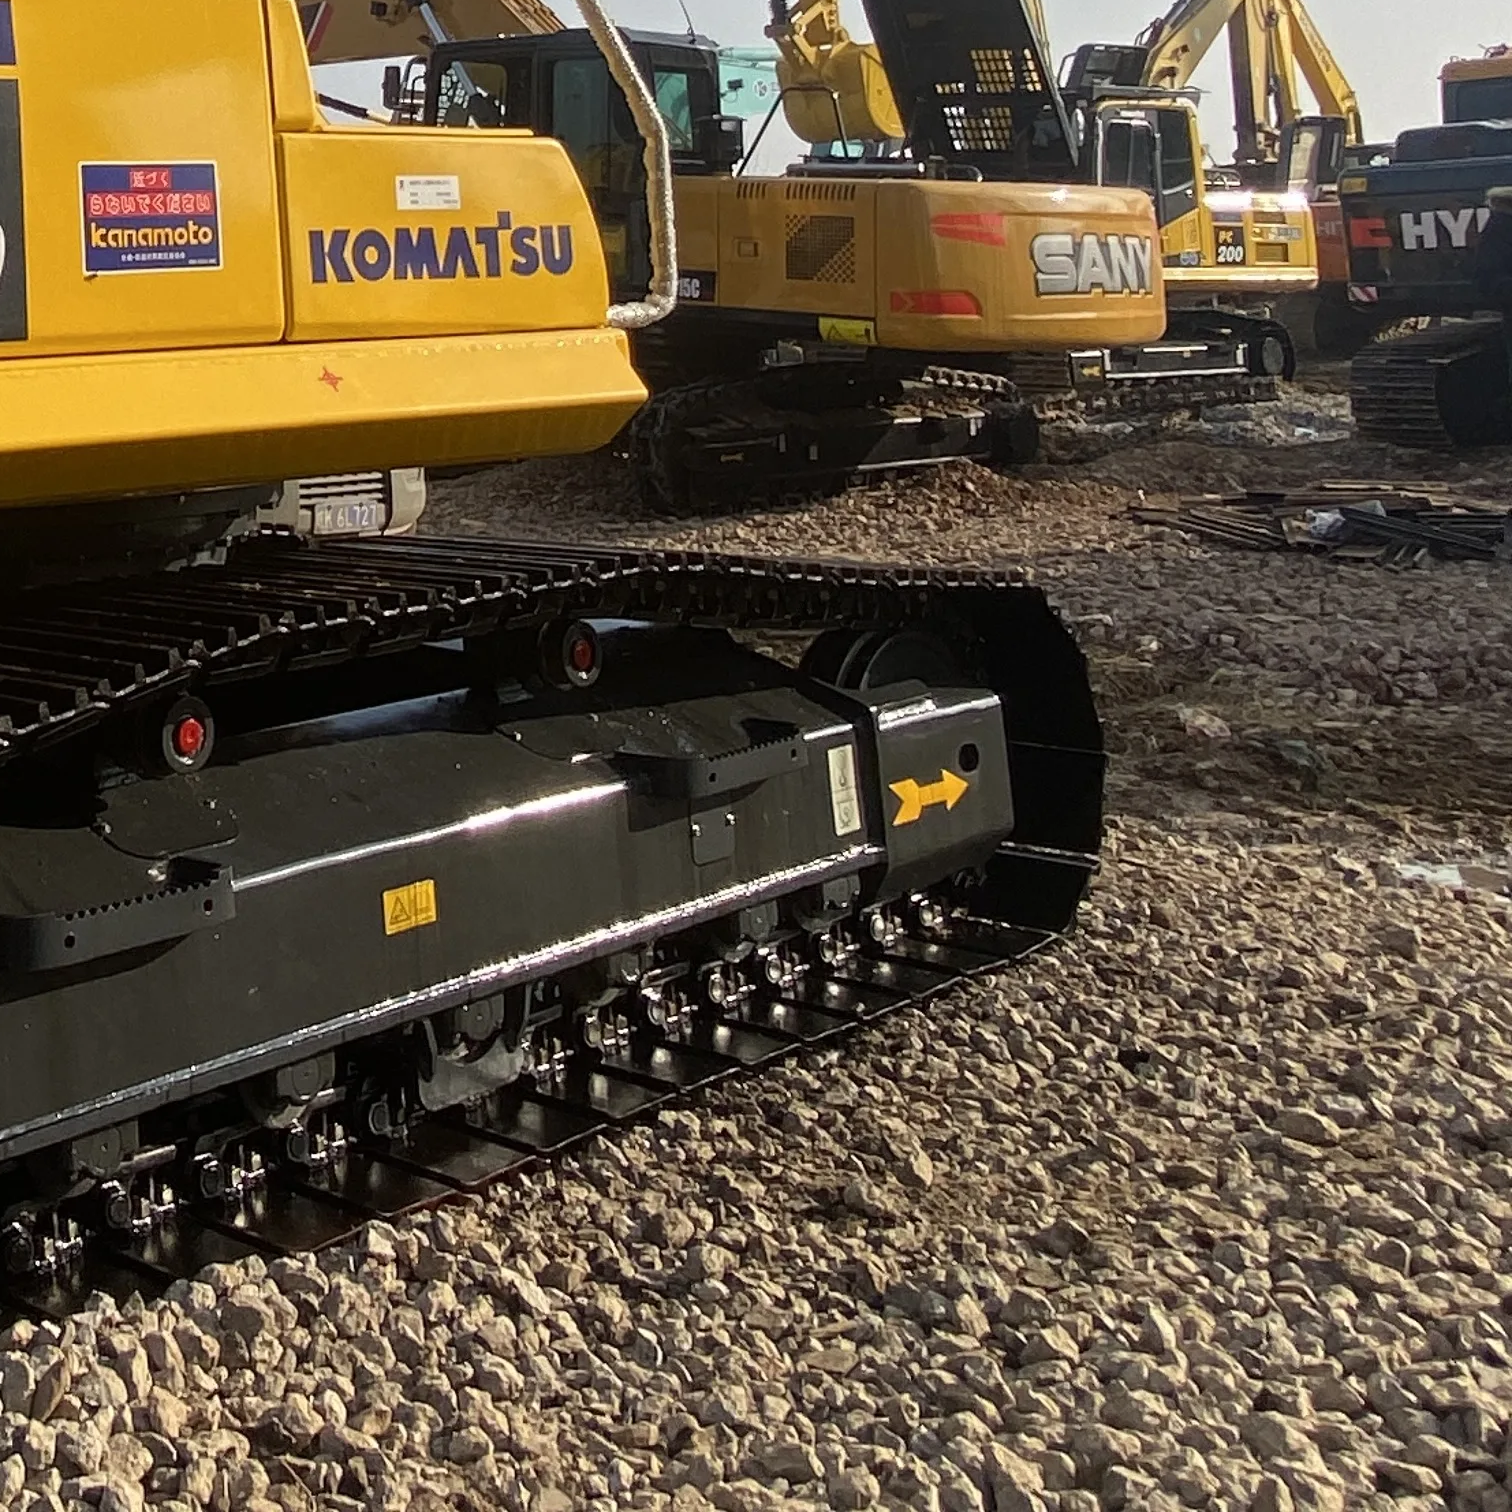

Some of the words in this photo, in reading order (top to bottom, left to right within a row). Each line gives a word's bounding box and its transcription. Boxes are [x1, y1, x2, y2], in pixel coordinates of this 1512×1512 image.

[90, 220, 213, 248] kanamoto
[308, 211, 574, 284] KOMATSU
[1216, 245, 1244, 263] 200
[1031, 233, 1152, 297] SANY
